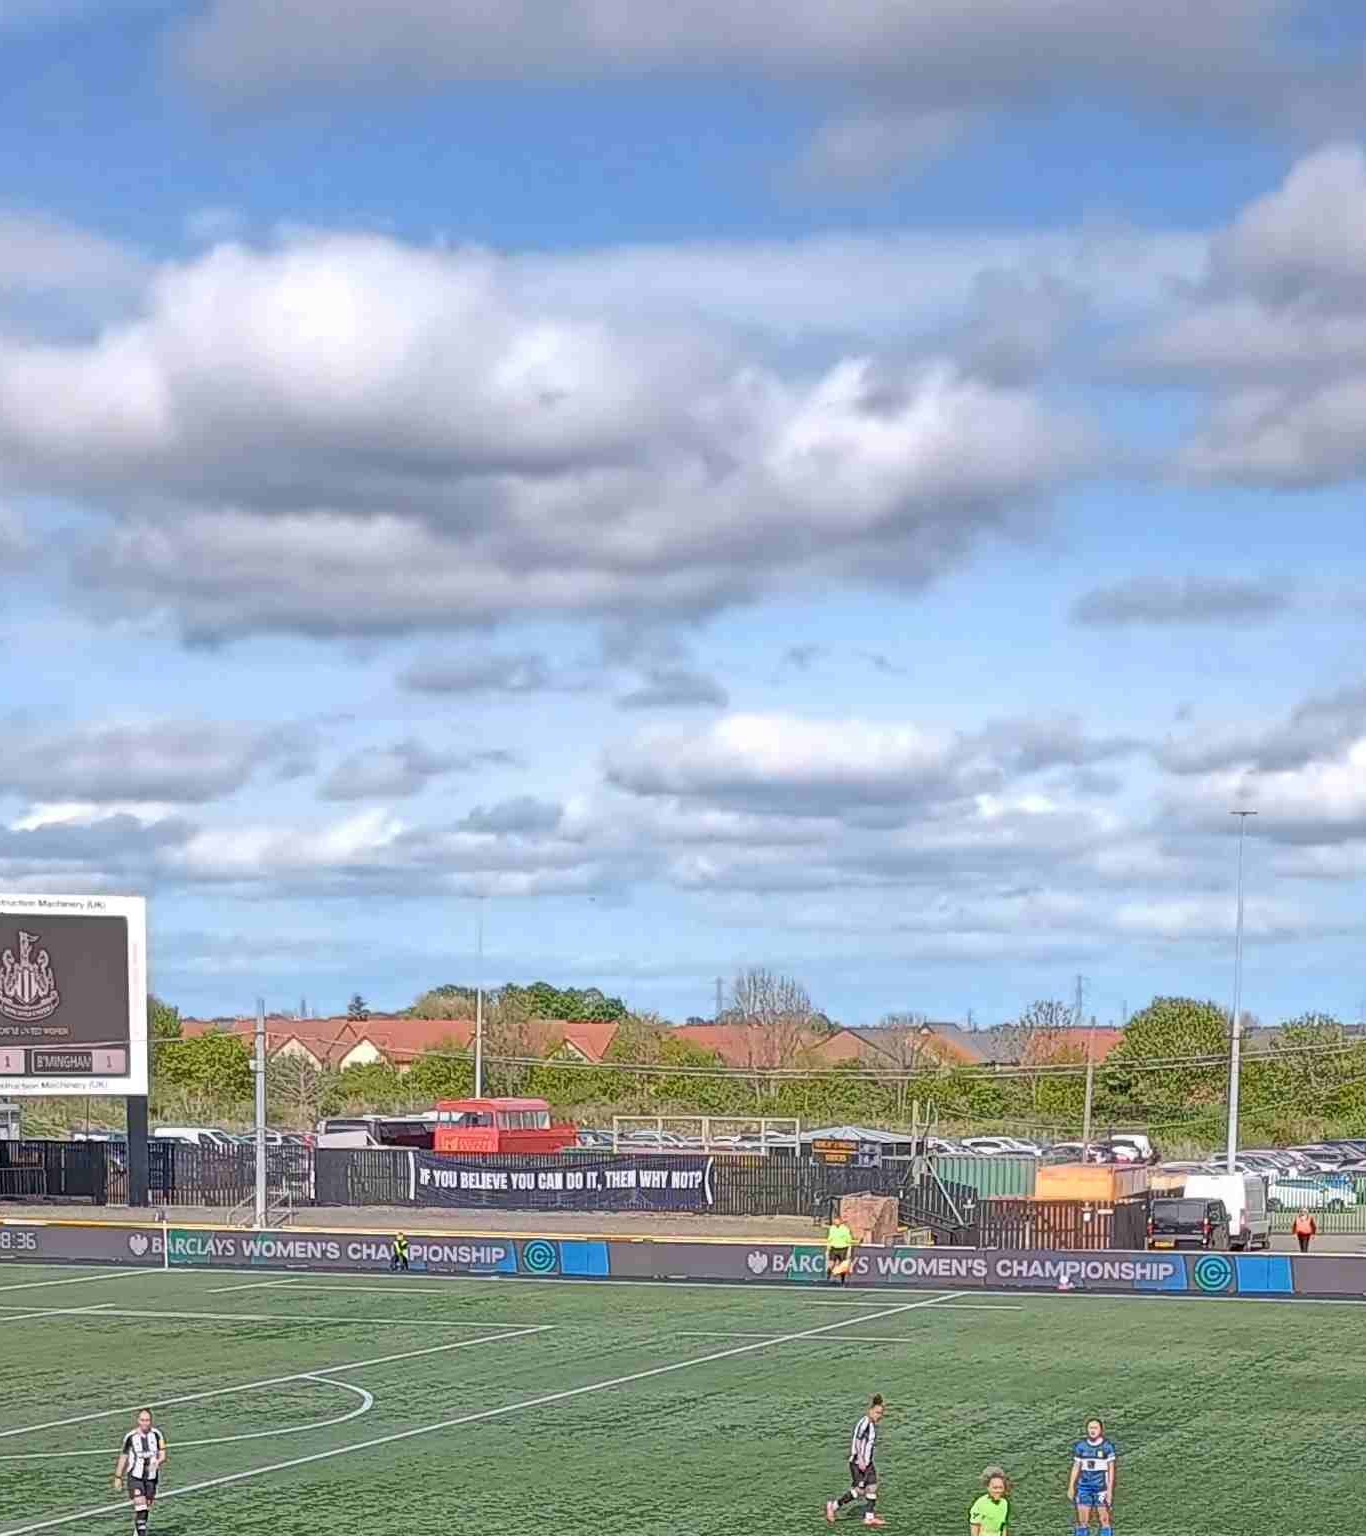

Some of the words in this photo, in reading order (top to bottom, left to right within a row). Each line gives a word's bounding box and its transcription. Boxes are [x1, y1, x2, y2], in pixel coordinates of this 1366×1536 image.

[433, 1170, 458, 1188] YOU
[460, 1171, 508, 1189] BELIEVE
[510, 1172, 535, 1190] YOU
[538, 1172, 563, 1190] CAN
[566, 1172, 583, 1189] DO
[605, 1170, 635, 1189] THEN
[639, 1170, 669, 1188] WHY
[672, 1170, 703, 1189] NOT?
[151, 1237, 235, 1258] BARCLAYS
[241, 1239, 341, 1260] WOMEN'S
[347, 1241, 506, 1264] CHAPIONSHIP
[772, 1254, 870, 1275] BARCYS
[876, 1256, 988, 1277] WOMEN'S
[995, 1258, 1174, 1282] CHAMPIONSHIP
